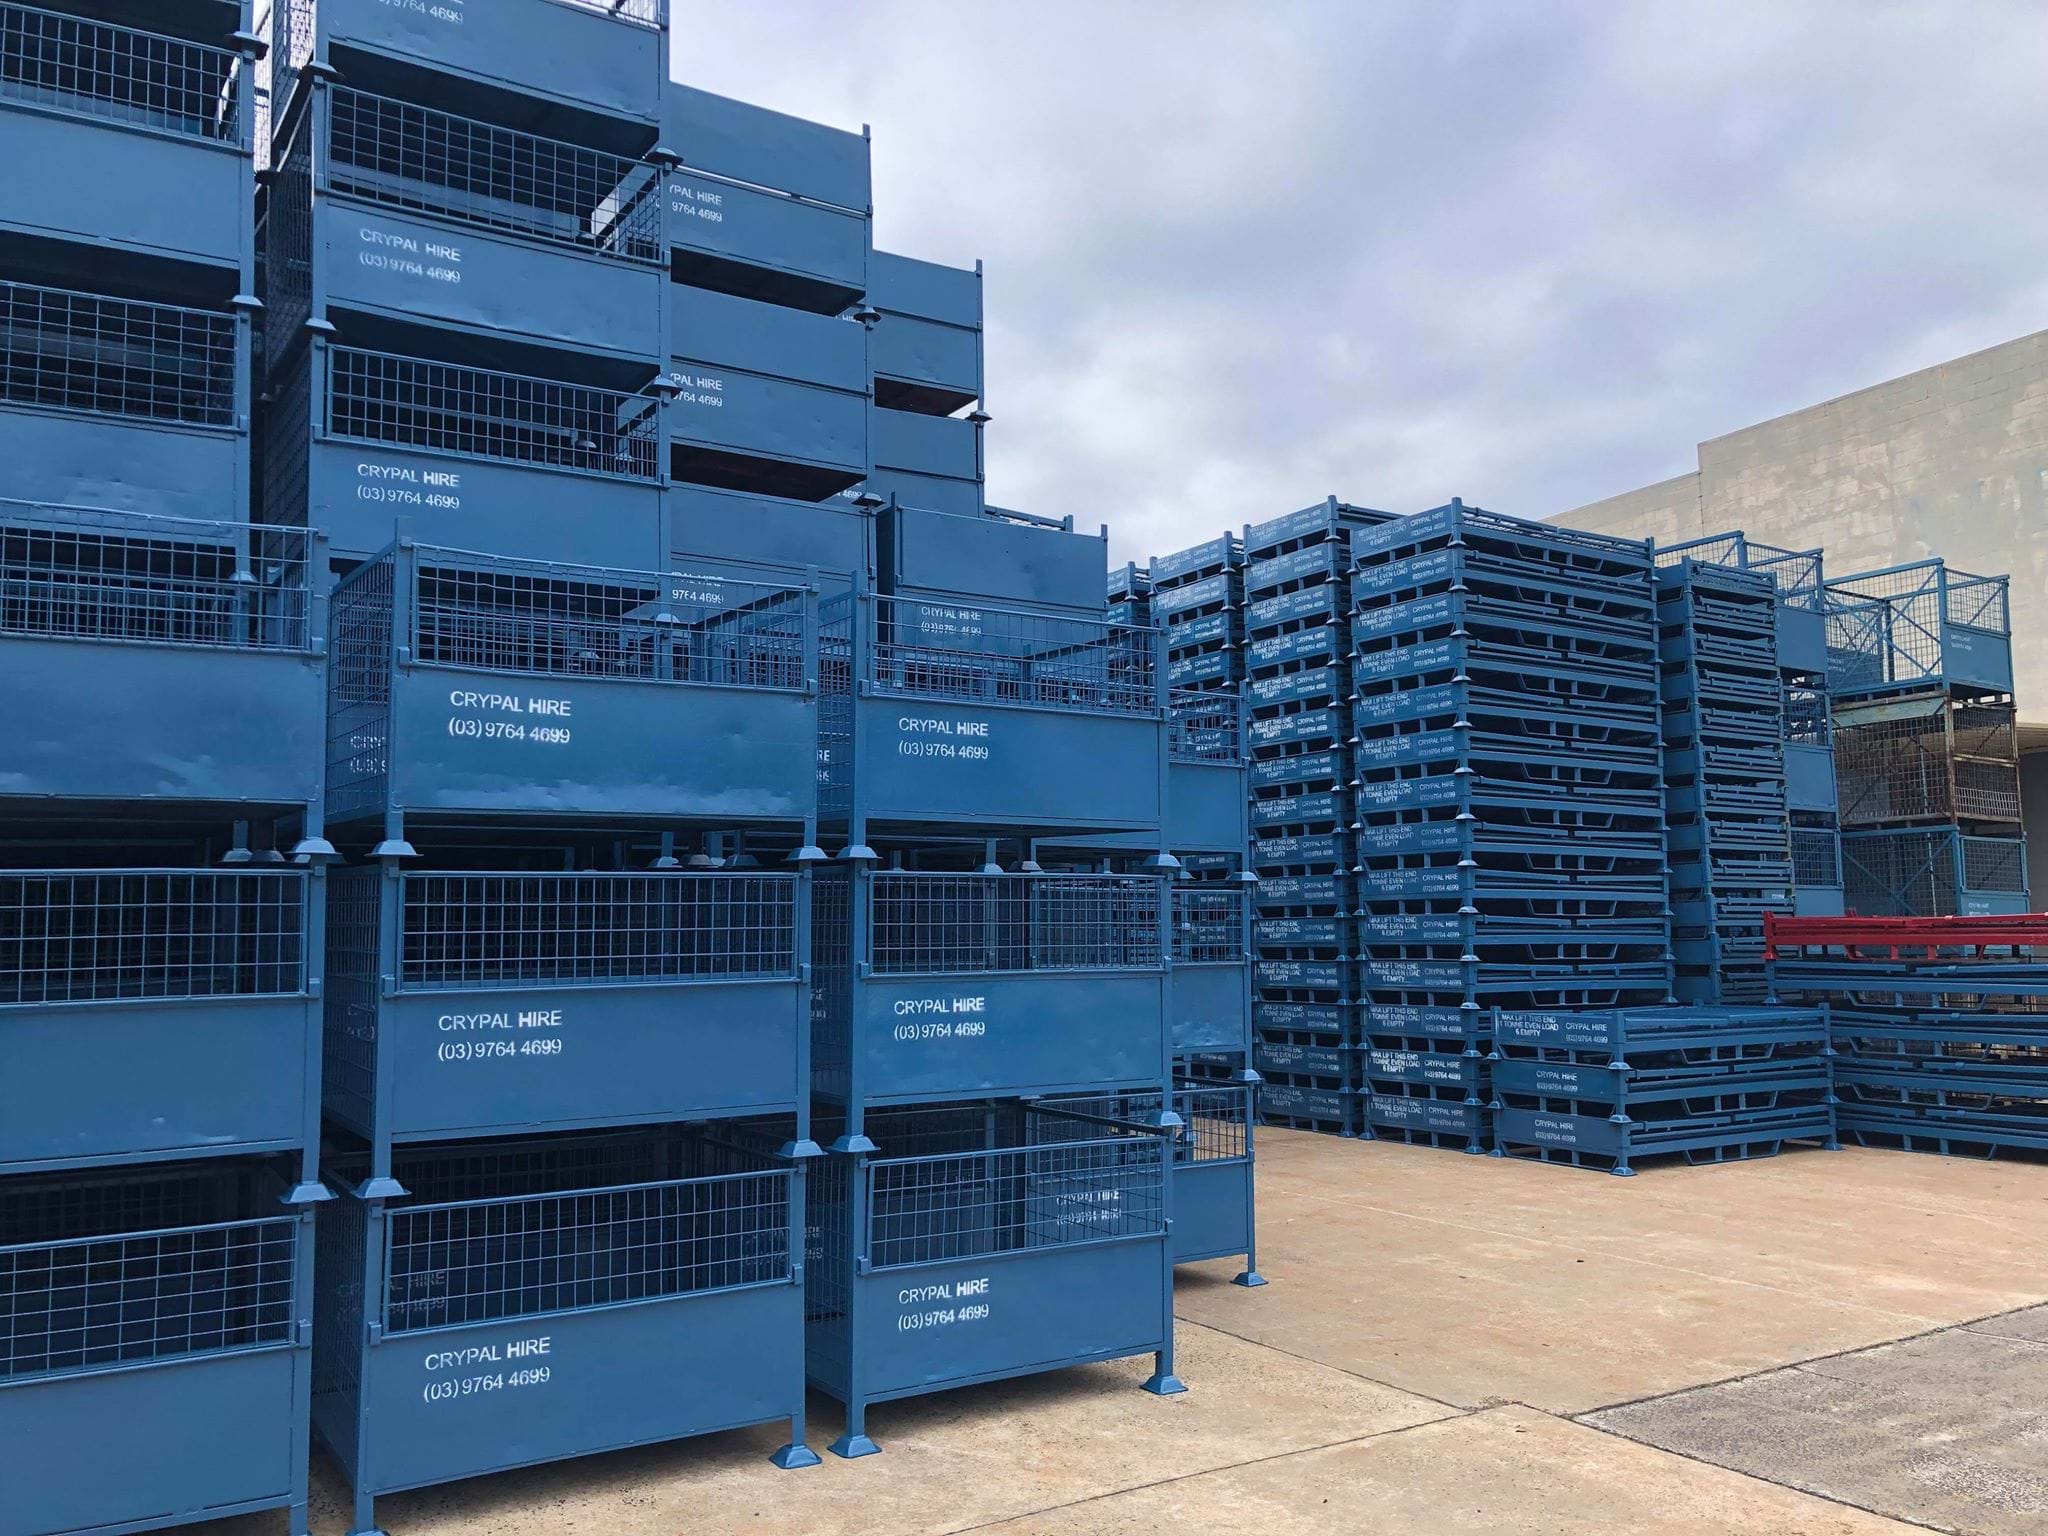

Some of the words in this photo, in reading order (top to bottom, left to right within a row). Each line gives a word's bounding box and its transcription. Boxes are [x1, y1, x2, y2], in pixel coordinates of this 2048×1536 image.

[430, 5, 463, 24] 4699
[697, 191, 722, 206] HIRE
[698, 208, 722, 222] 4699
[360, 230, 418, 253] CRYPAL
[426, 244, 460, 261] HIRE
[427, 268, 460, 282] 4699
[697, 377, 722, 391] HIRE
[699, 395, 722, 407] 4699
[358, 464, 418, 482] CRYPAL
[424, 471, 459, 486] HIRE
[426, 494, 459, 509] 4699
[699, 593, 723, 604] 4699
[921, 606, 957, 619] CRYPAL
[959, 611, 981, 620] HIRE
[451, 691, 523, 712] CRYPAL
[529, 699, 571, 716] HIRE
[899, 718, 953, 733] CRYPAL
[957, 722, 988, 736] HIRE
[530, 727, 570, 743] 4699
[817, 750, 830, 761] RE
[959, 746, 988, 759] 4699
[895, 999, 949, 1015] CRYPAL
[953, 997, 984, 1012] HIRE
[439, 1014, 512, 1030] CRYPAL
[519, 1010, 561, 1027] HIRE
[1566, 1022, 1590, 1030] CRYPAL
[955, 1022, 985, 1036] 4699
[521, 1039, 561, 1055] 4699
[1536, 1070, 1560, 1079] CRYPAL
[1562, 1072, 1577, 1081] HIRE
[1535, 1119, 1559, 1129] CRYPAL
[1560, 1122, 1574, 1130] HIRE
[899, 1285, 952, 1304] CRYPAL
[957, 1278, 988, 1296] HIRE
[958, 1304, 988, 1320] 4699
[425, 1346, 501, 1369] CRYPAL
[507, 1337, 550, 1358] HIRE
[509, 1367, 549, 1386] 4699
